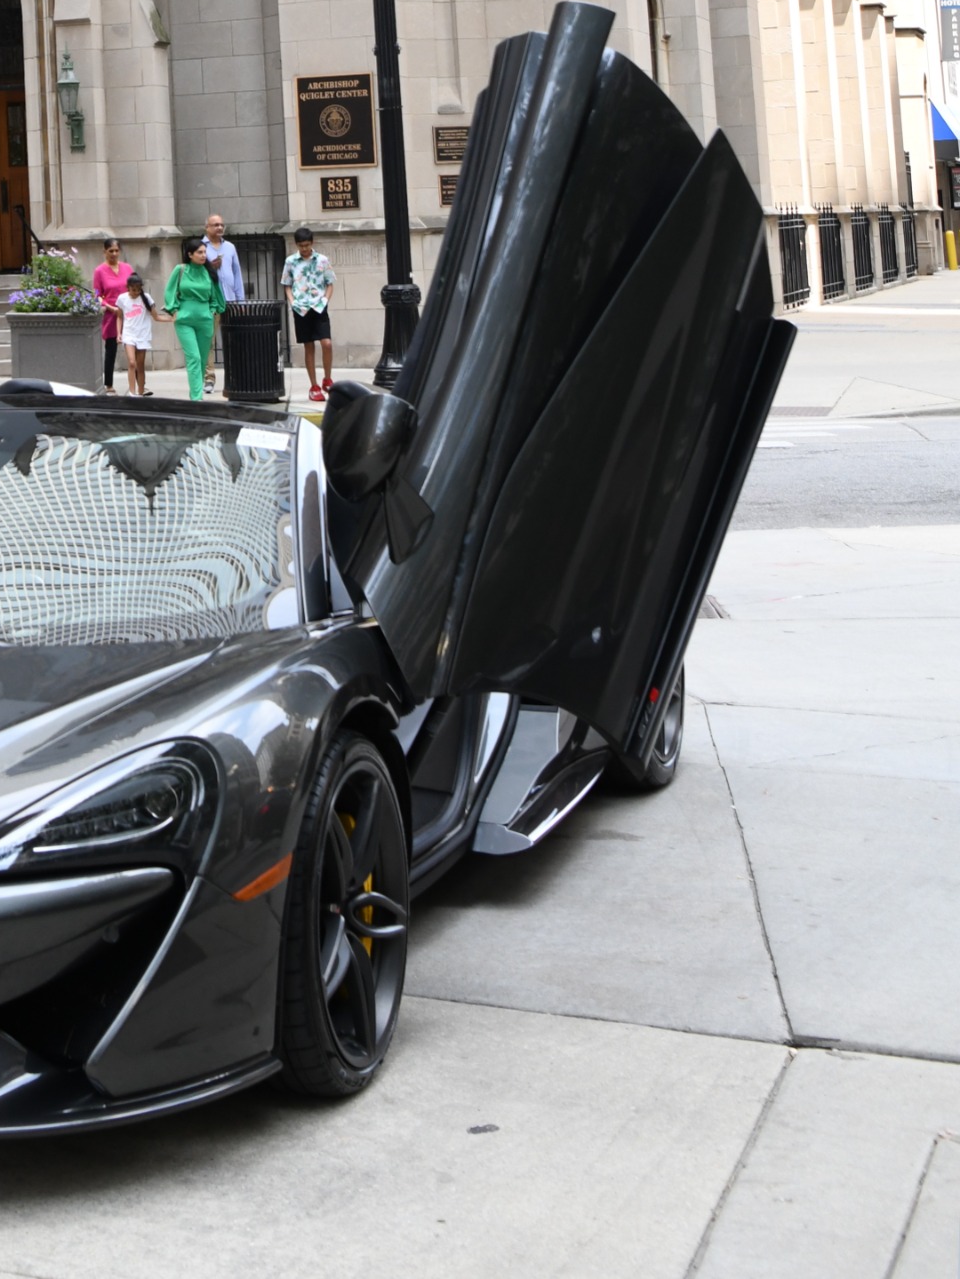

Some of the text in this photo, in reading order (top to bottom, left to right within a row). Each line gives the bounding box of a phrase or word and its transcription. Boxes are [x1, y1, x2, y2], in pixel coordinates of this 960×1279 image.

[307, 80, 360, 90] ARCHBISHOP
[300, 89, 369, 101] QUIGLEY CENTER
[313, 144, 362, 153] ARCHDIOCESE
[327, 152, 359, 160] CHICAGO
[327, 178, 352, 192] 835
